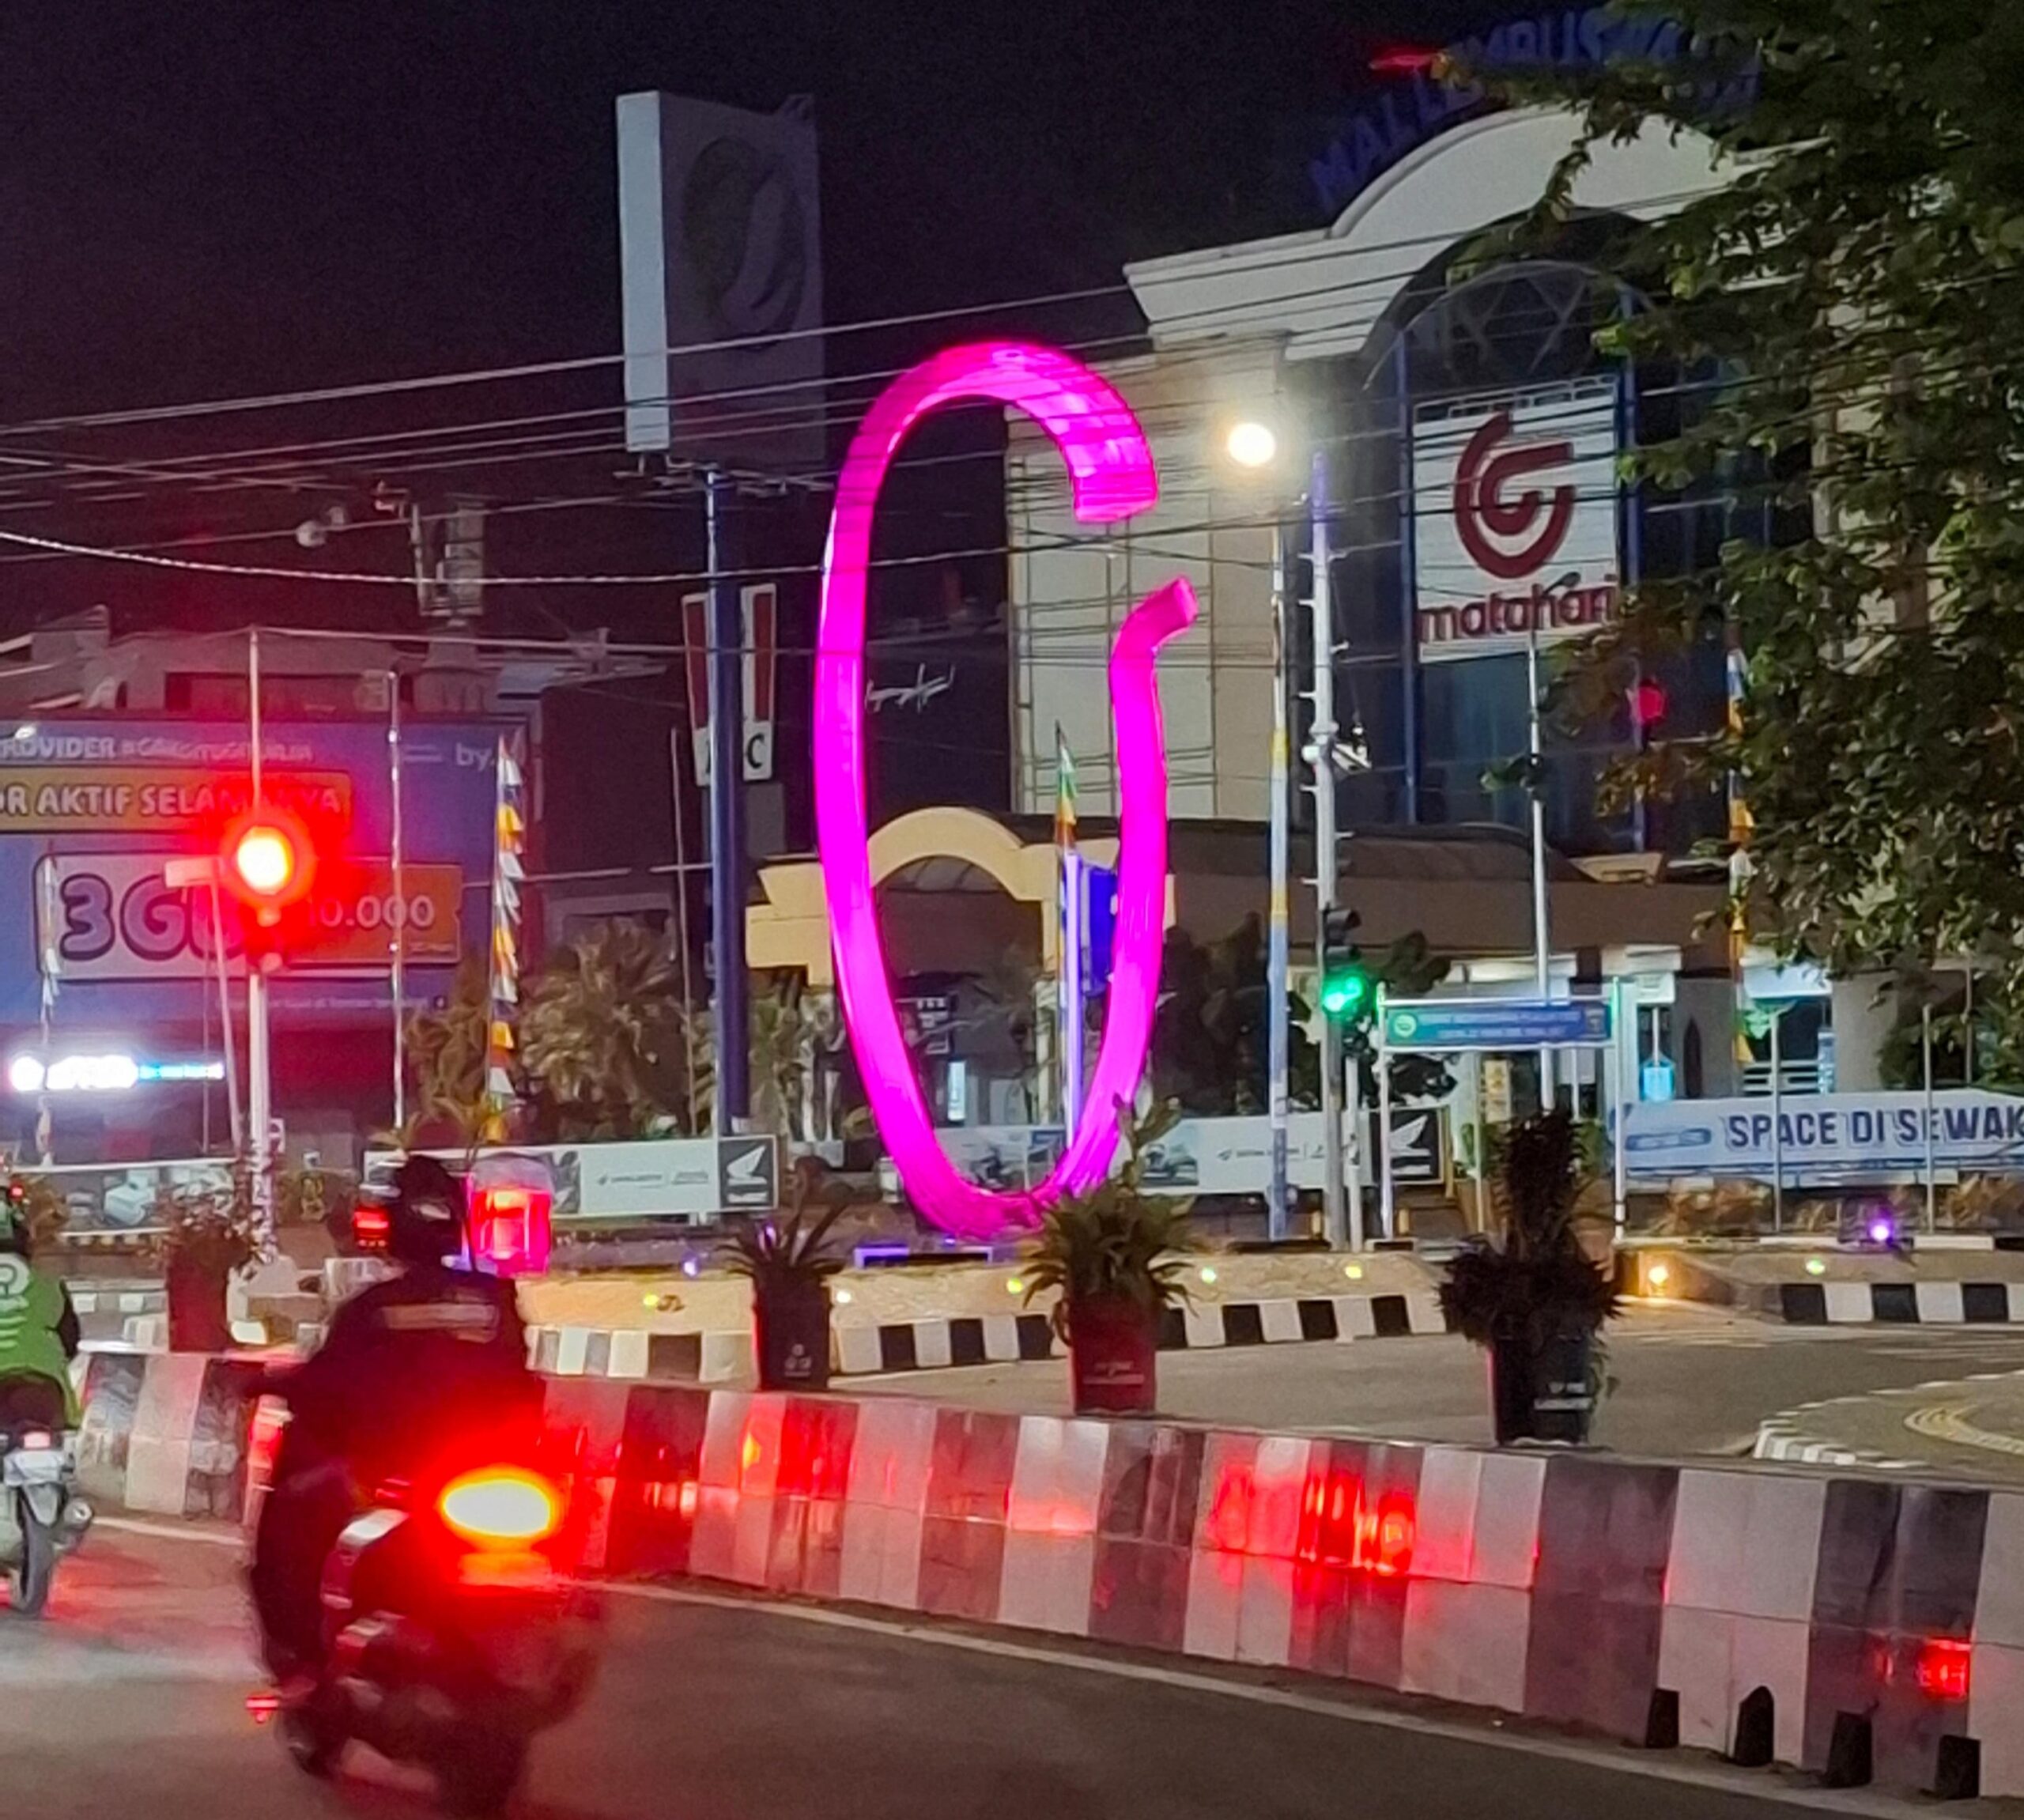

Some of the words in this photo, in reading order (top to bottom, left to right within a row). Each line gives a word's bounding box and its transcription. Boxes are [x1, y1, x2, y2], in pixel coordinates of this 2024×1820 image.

[0, 737, 116, 758] ROVIDER
[36, 785, 130, 815] AKTIF
[1728, 1112, 1837, 1146] SPACE
[1852, 1110, 1885, 1143] DI
